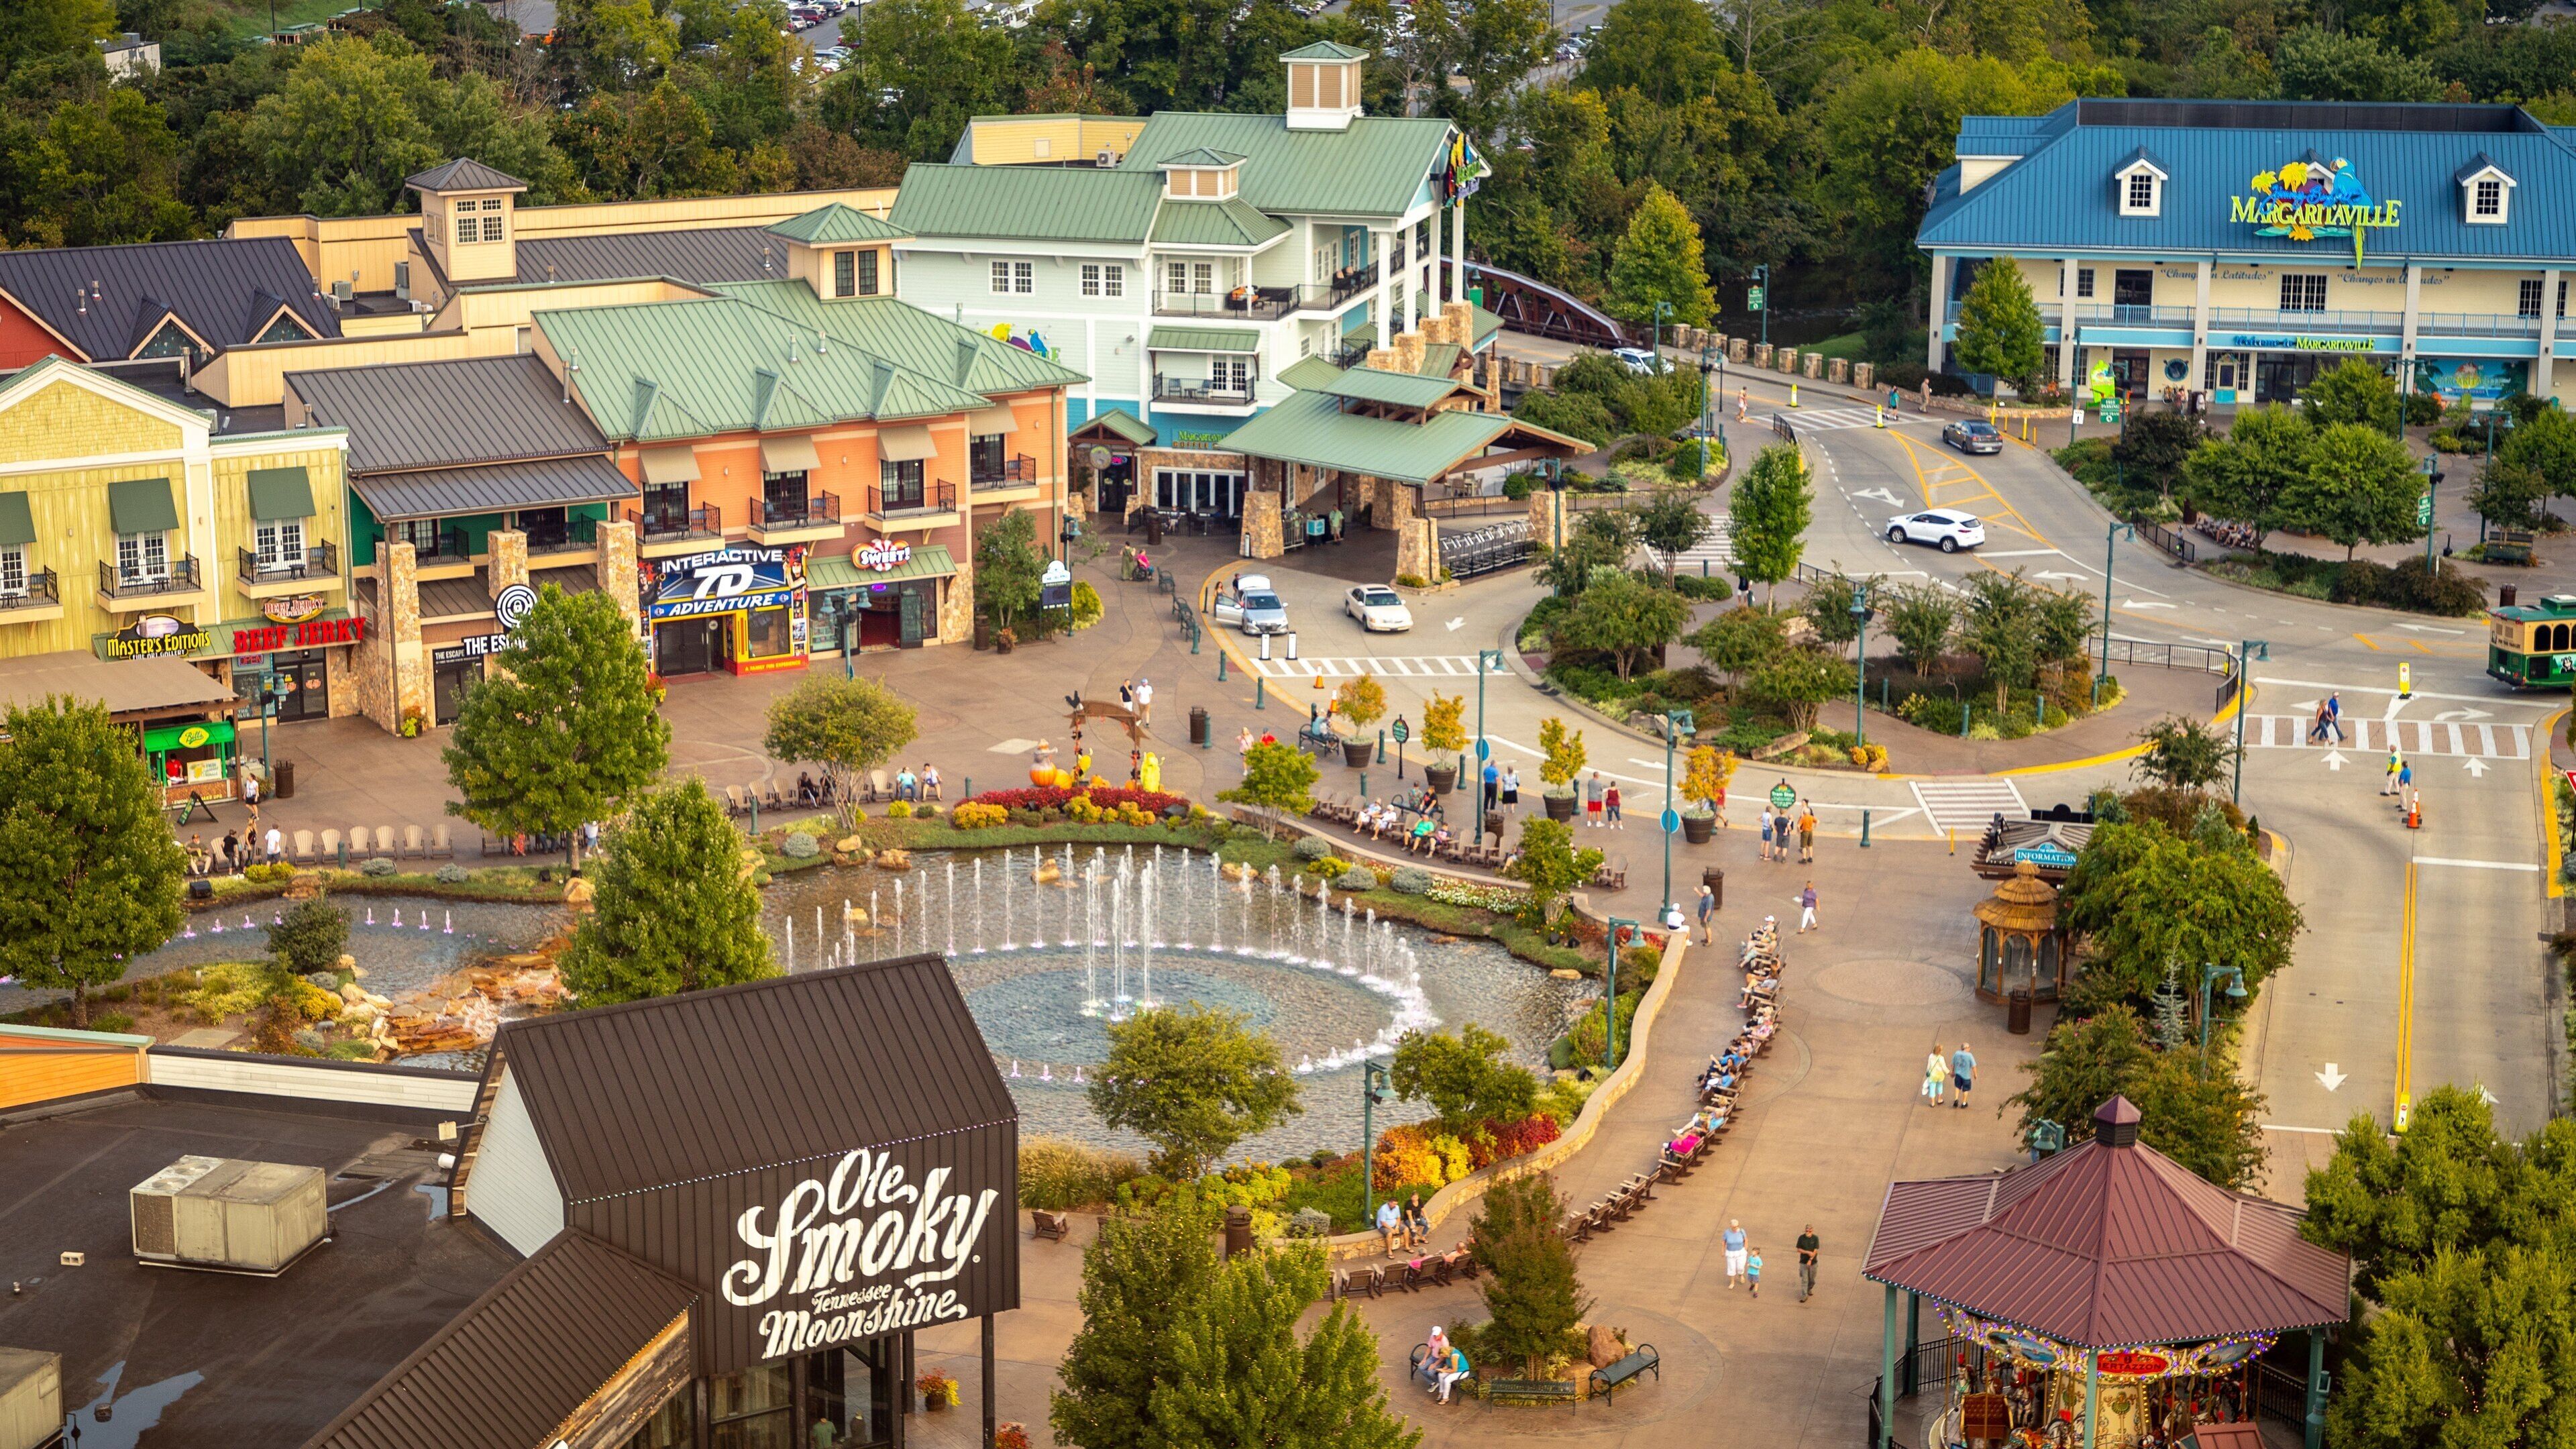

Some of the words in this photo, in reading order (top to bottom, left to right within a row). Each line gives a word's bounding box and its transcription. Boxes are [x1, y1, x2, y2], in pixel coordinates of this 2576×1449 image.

[2230, 195, 2402, 227] MARGARITAVILLE
[2386, 275, 2395, 284] in
[2296, 336, 2375, 350] MARGARITAVILLE
[661, 549, 784, 574] INTERACTIVE
[860, 546, 910, 566] SWEET!
[693, 563, 754, 600] 7D
[668, 593, 775, 616] ADVENTURE
[107, 637, 162, 657] MASTER'S
[164, 631, 211, 651] EDITIONS
[233, 625, 288, 653] BEEF
[294, 616, 366, 647] JERKY
[464, 635, 488, 656] THE
[240, 654, 263, 665] OPEN
[435, 651, 445, 660] THE
[445, 649, 464, 659] ESCAPE
[2017, 851, 2077, 863] INFORMATION
[828, 1148, 918, 1216] Ole
[812, 1284, 892, 1315] Tennessee
[759, 1288, 968, 1360] Moonshine
